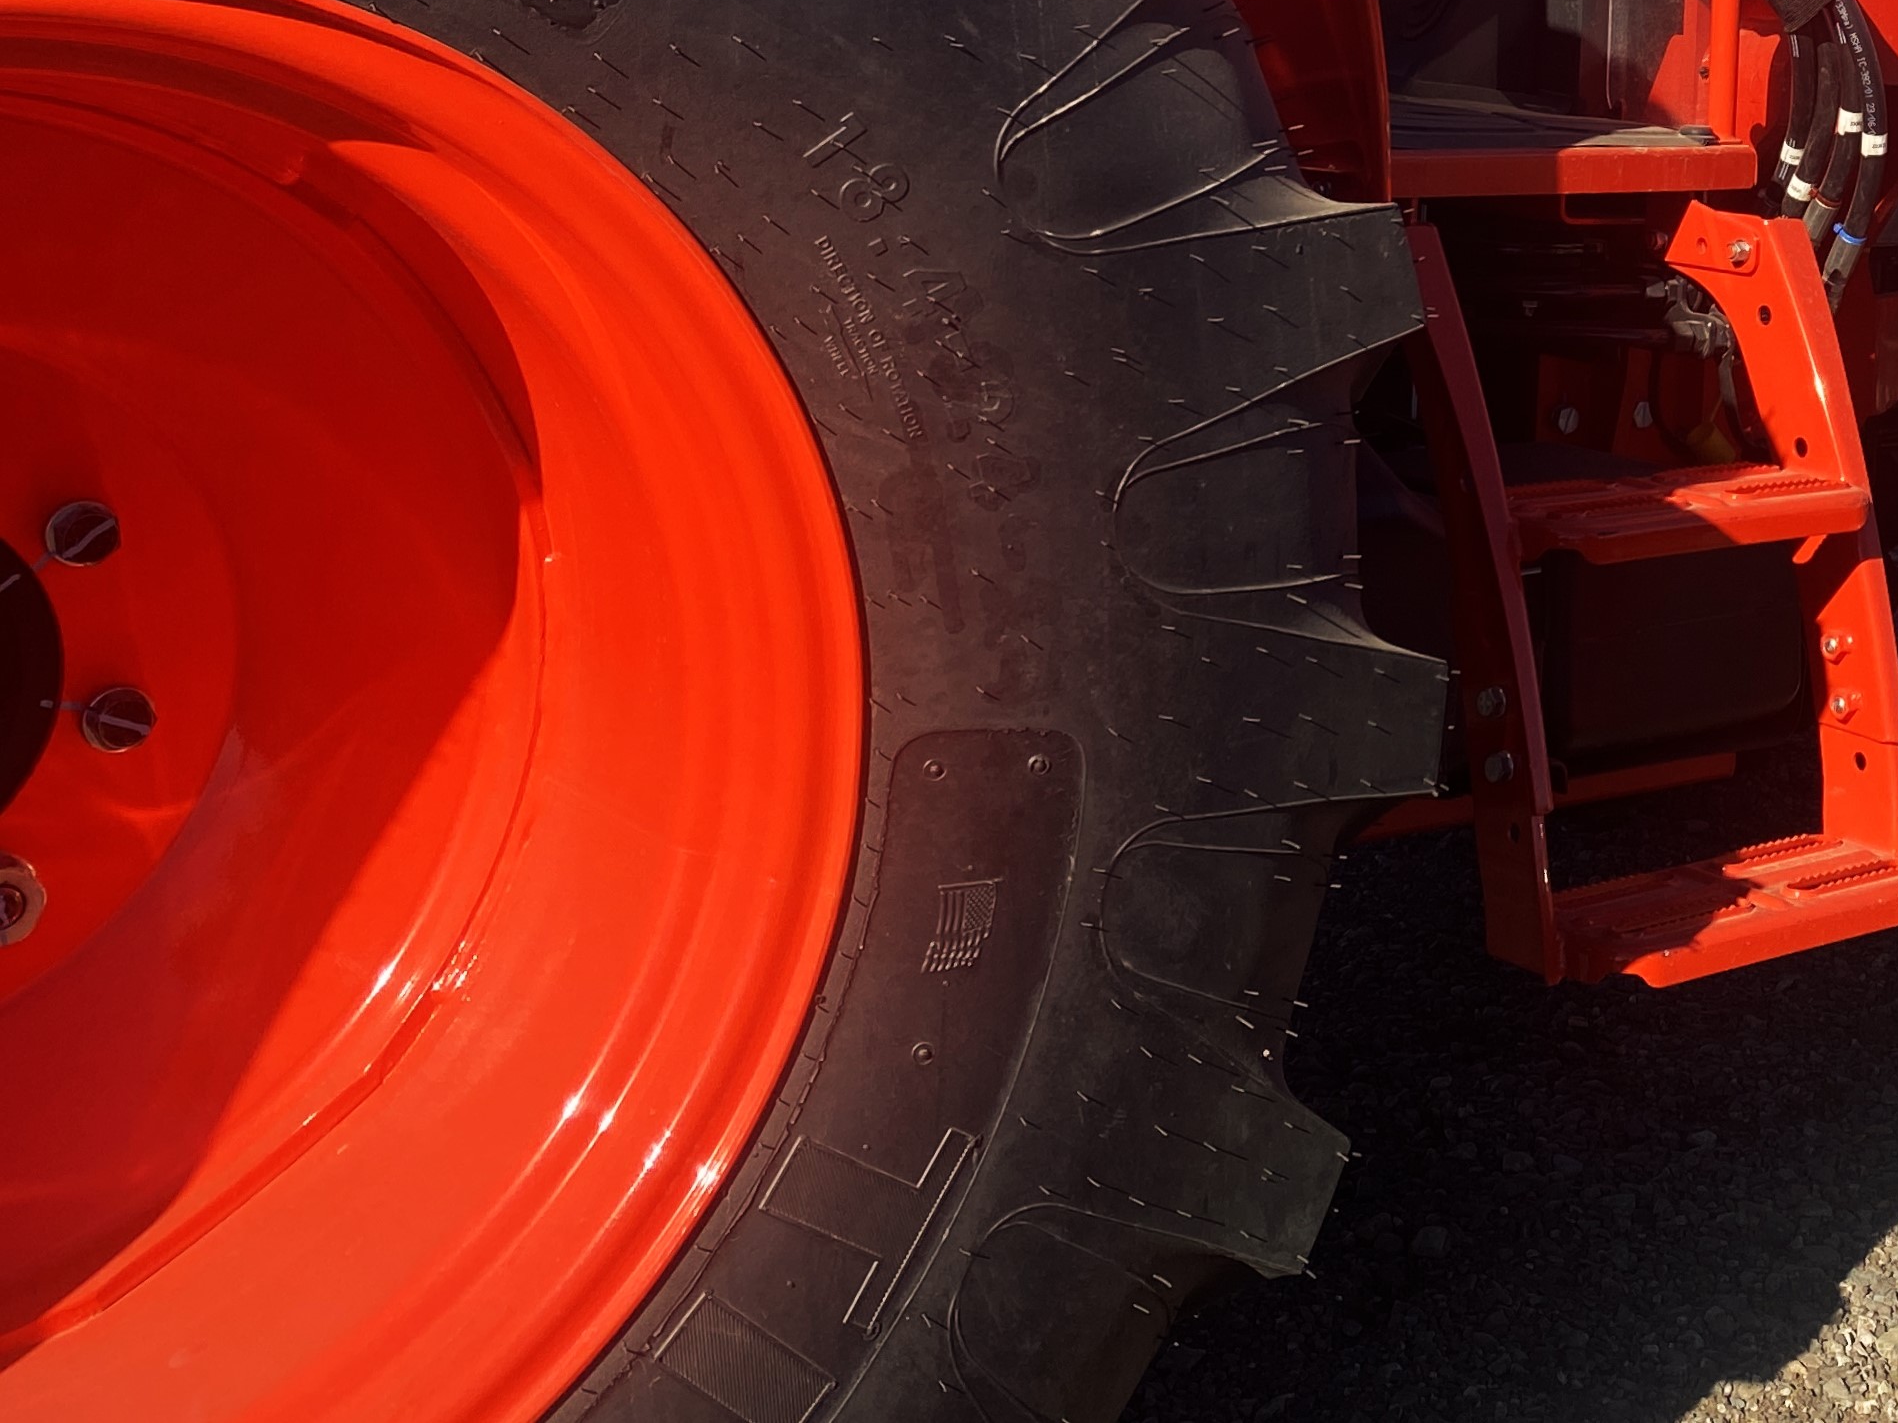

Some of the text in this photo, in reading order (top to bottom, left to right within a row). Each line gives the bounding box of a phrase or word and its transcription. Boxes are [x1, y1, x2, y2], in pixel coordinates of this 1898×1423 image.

[814, 235, 926, 439] DIRECTION OF ROTATION
[844, 318, 880, 376] TRACTION
